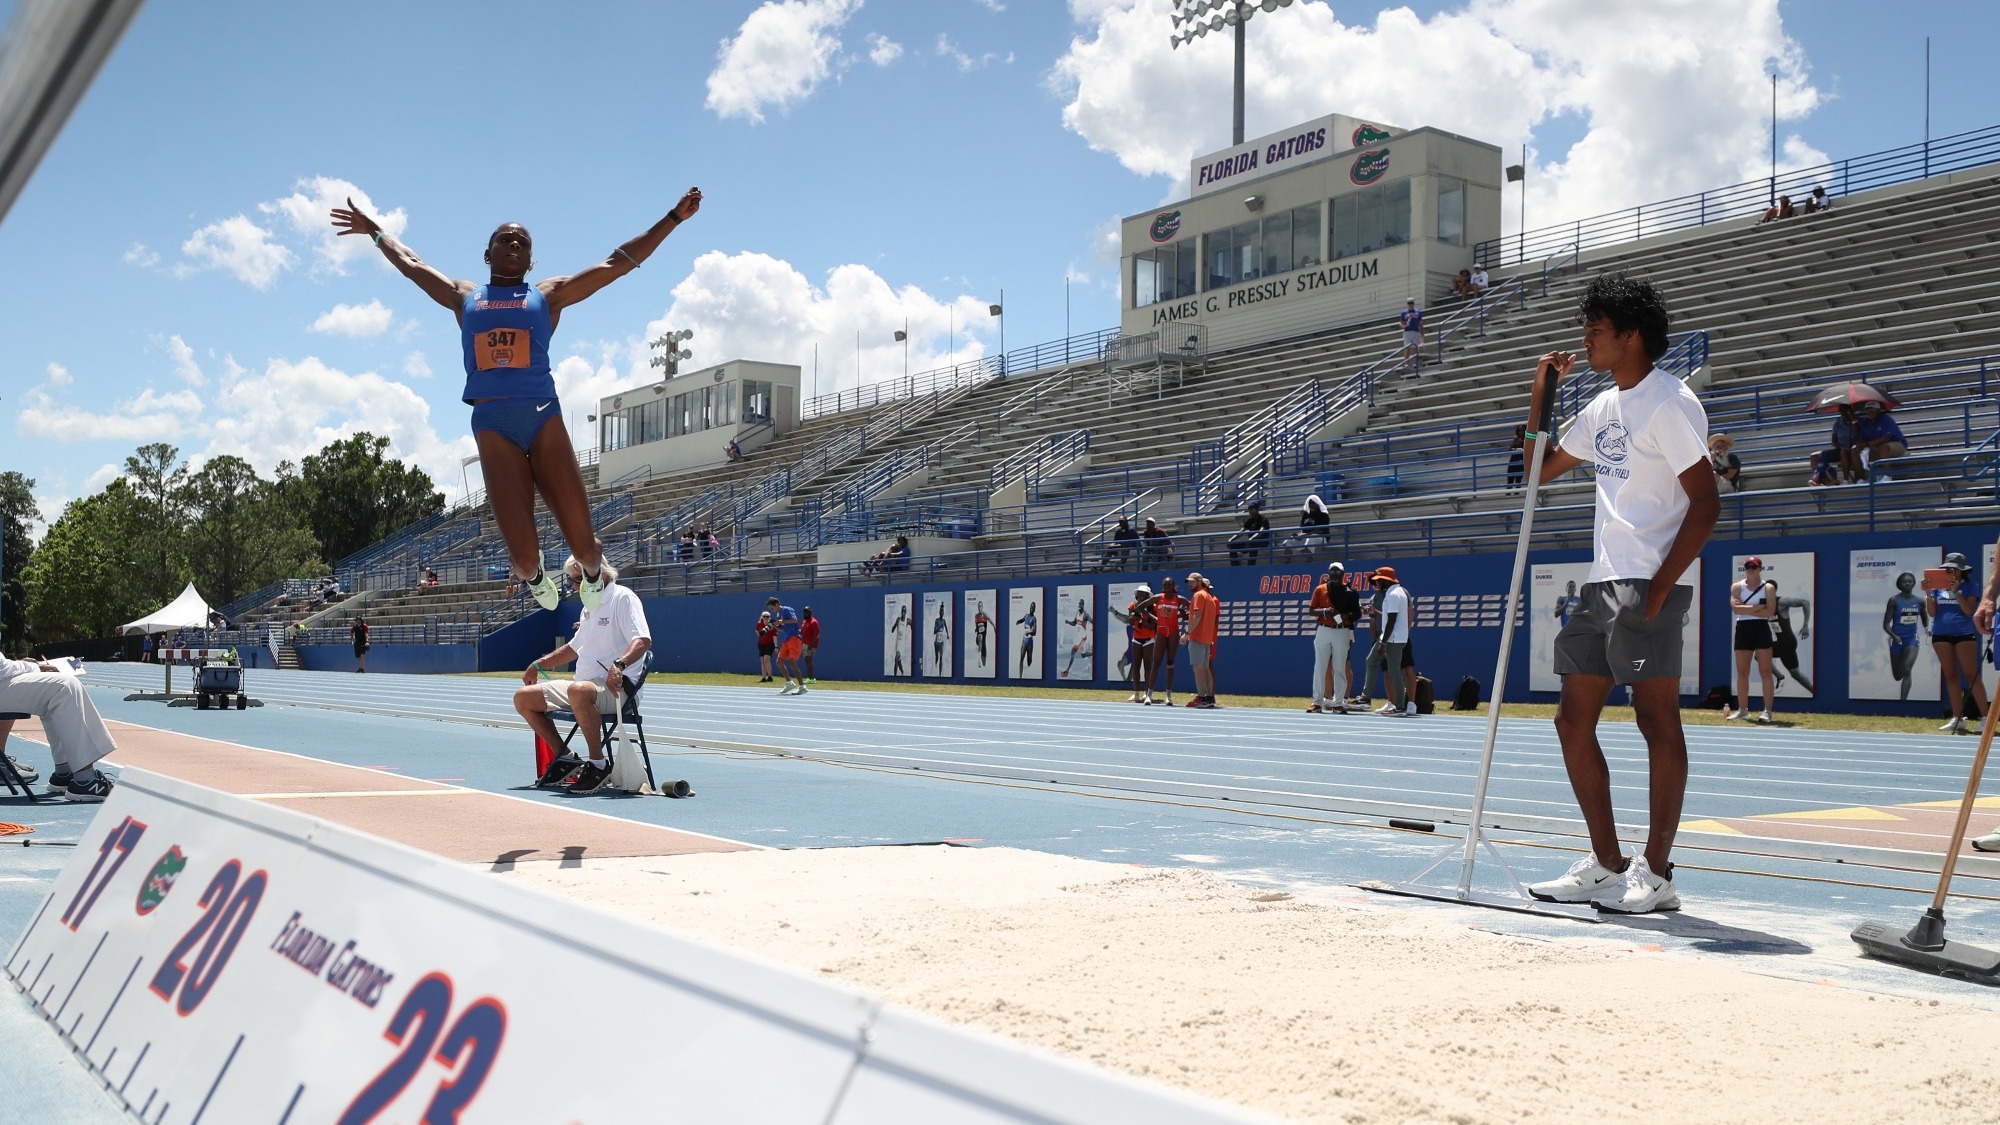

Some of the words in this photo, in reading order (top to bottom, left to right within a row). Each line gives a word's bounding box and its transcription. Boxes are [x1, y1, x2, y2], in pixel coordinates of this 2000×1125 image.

[1198, 149, 1259, 187] FLORIDA
[1265, 127, 1326, 165] GATORS
[475, 299, 528, 311] FLORIDA
[1152, 300, 1198, 326] JAMES
[1206, 296, 1220, 313] G.
[1228, 279, 1289, 308] PRESSLY
[1297, 258, 1378, 292] STADIUM
[487, 331, 516, 348] 347
[1595, 464, 1612, 476] ACK
[1259, 574, 1312, 595] GATOR
[1319, 571, 1382, 592] EAT
[61, 815, 148, 932] 17
[148, 859, 269, 1018] 20
[270, 910, 336, 977] FLORIDA
[326, 939, 395, 1010] GATORS
[335, 971, 508, 1125] 23
